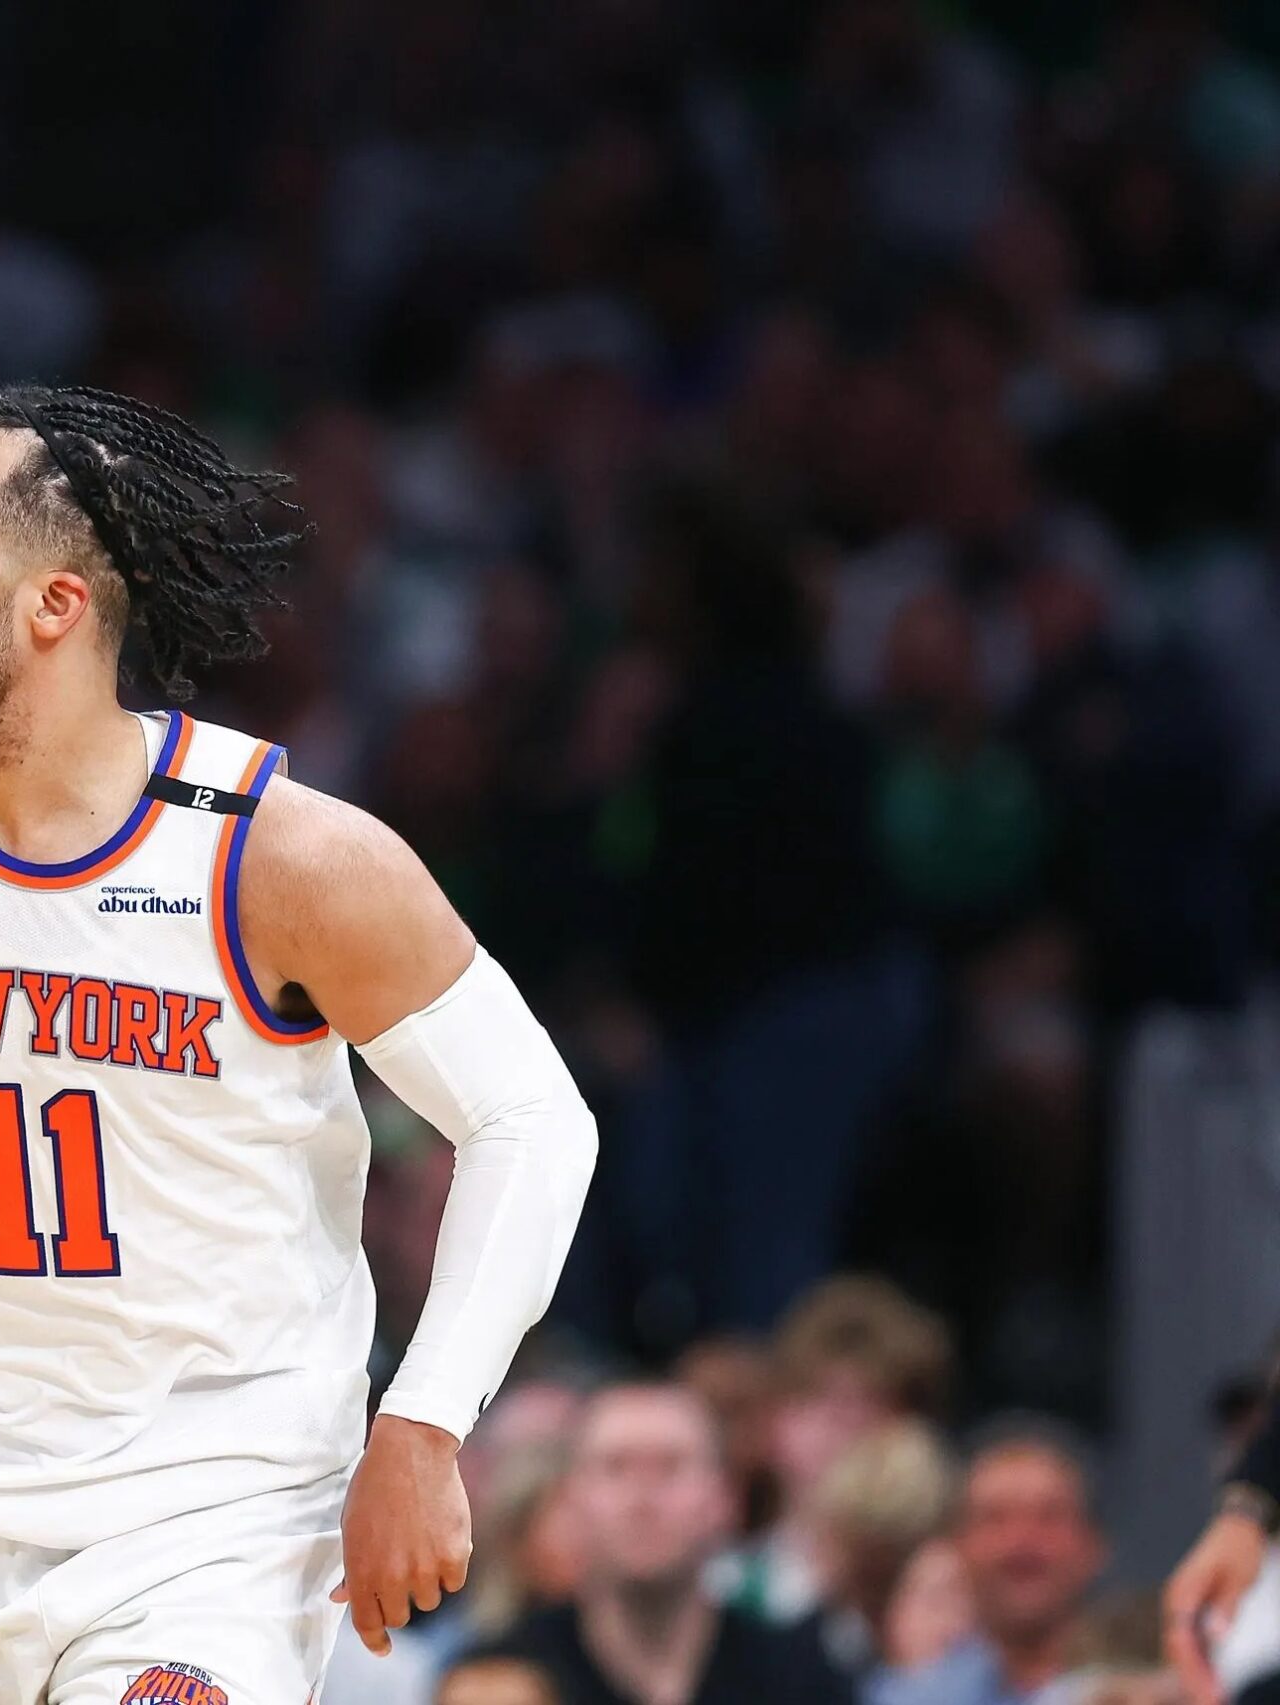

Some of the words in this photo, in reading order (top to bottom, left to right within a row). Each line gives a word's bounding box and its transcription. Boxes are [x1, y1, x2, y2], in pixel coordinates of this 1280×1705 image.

[192, 787, 215, 810] 12
[101, 886, 156, 894] experience
[98, 896, 137, 912] abu
[141, 896, 202, 914] dhabi
[18, 972, 224, 1081] YORK
[165, 1662, 189, 1672] NEW
[190, 1665, 213, 1685] YORK
